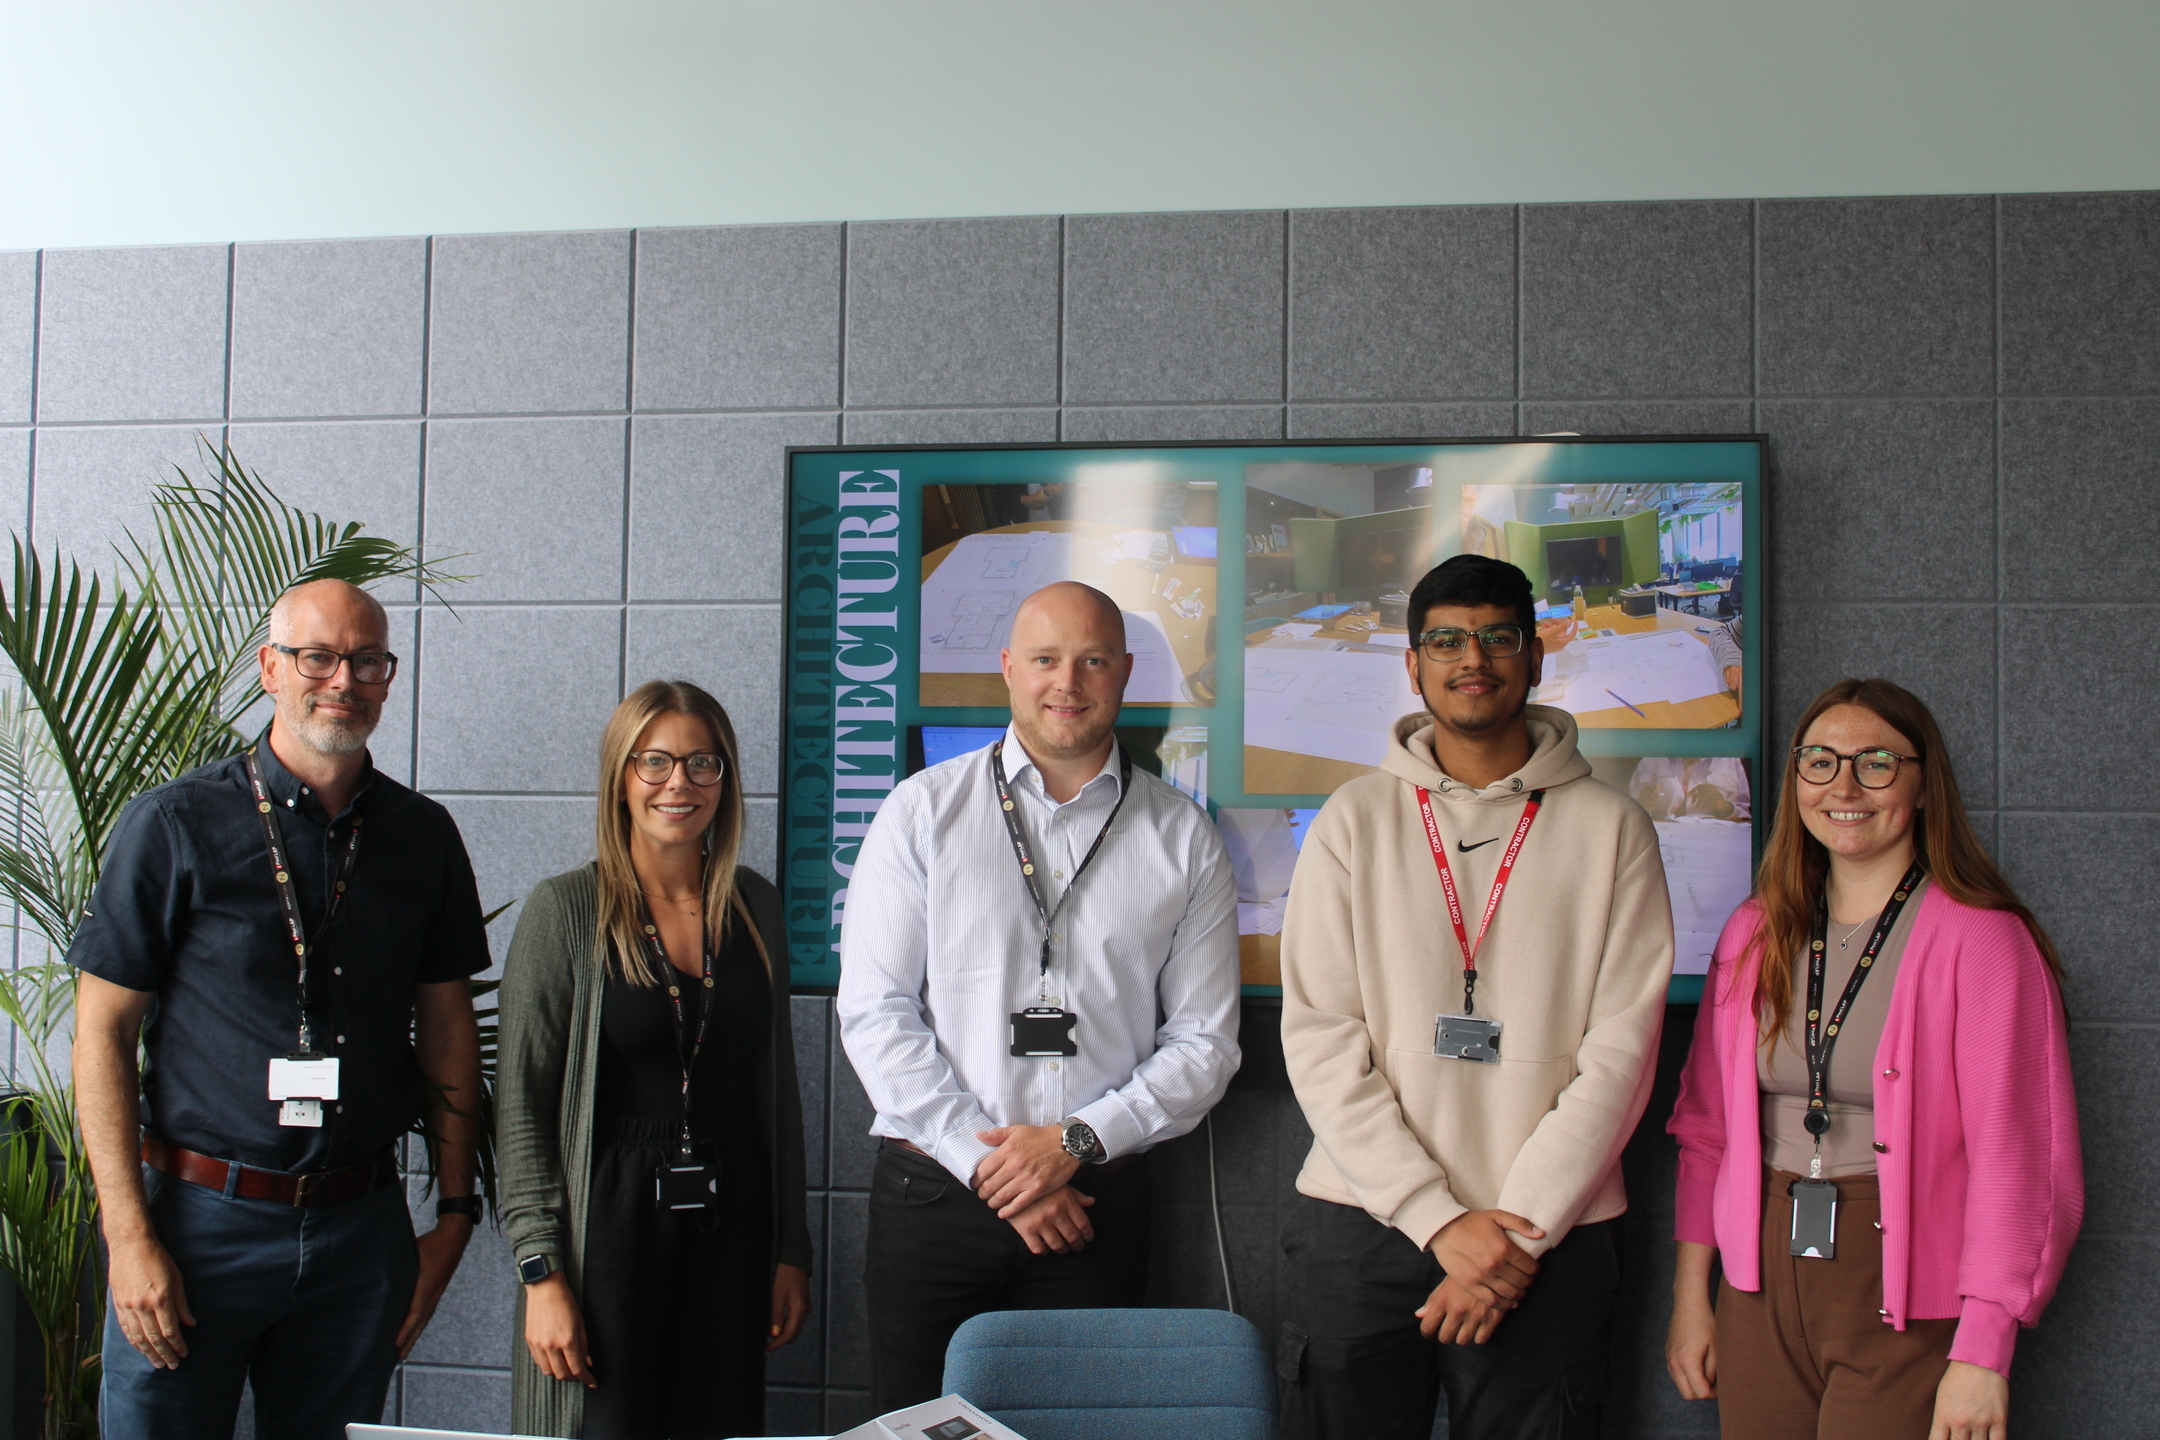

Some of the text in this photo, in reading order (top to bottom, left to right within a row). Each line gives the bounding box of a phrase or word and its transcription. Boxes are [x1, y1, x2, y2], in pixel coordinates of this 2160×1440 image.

[788, 491, 834, 967] ARCHITECTURE
[831, 469, 900, 954] HITECTURE
[1422, 802, 1442, 853] CONTRACTOR
[1503, 817, 1530, 868] CONTRACTOR
[1440, 868, 1460, 925] CONTRACTOR
[1479, 883, 1502, 938] CONTRACTOR
